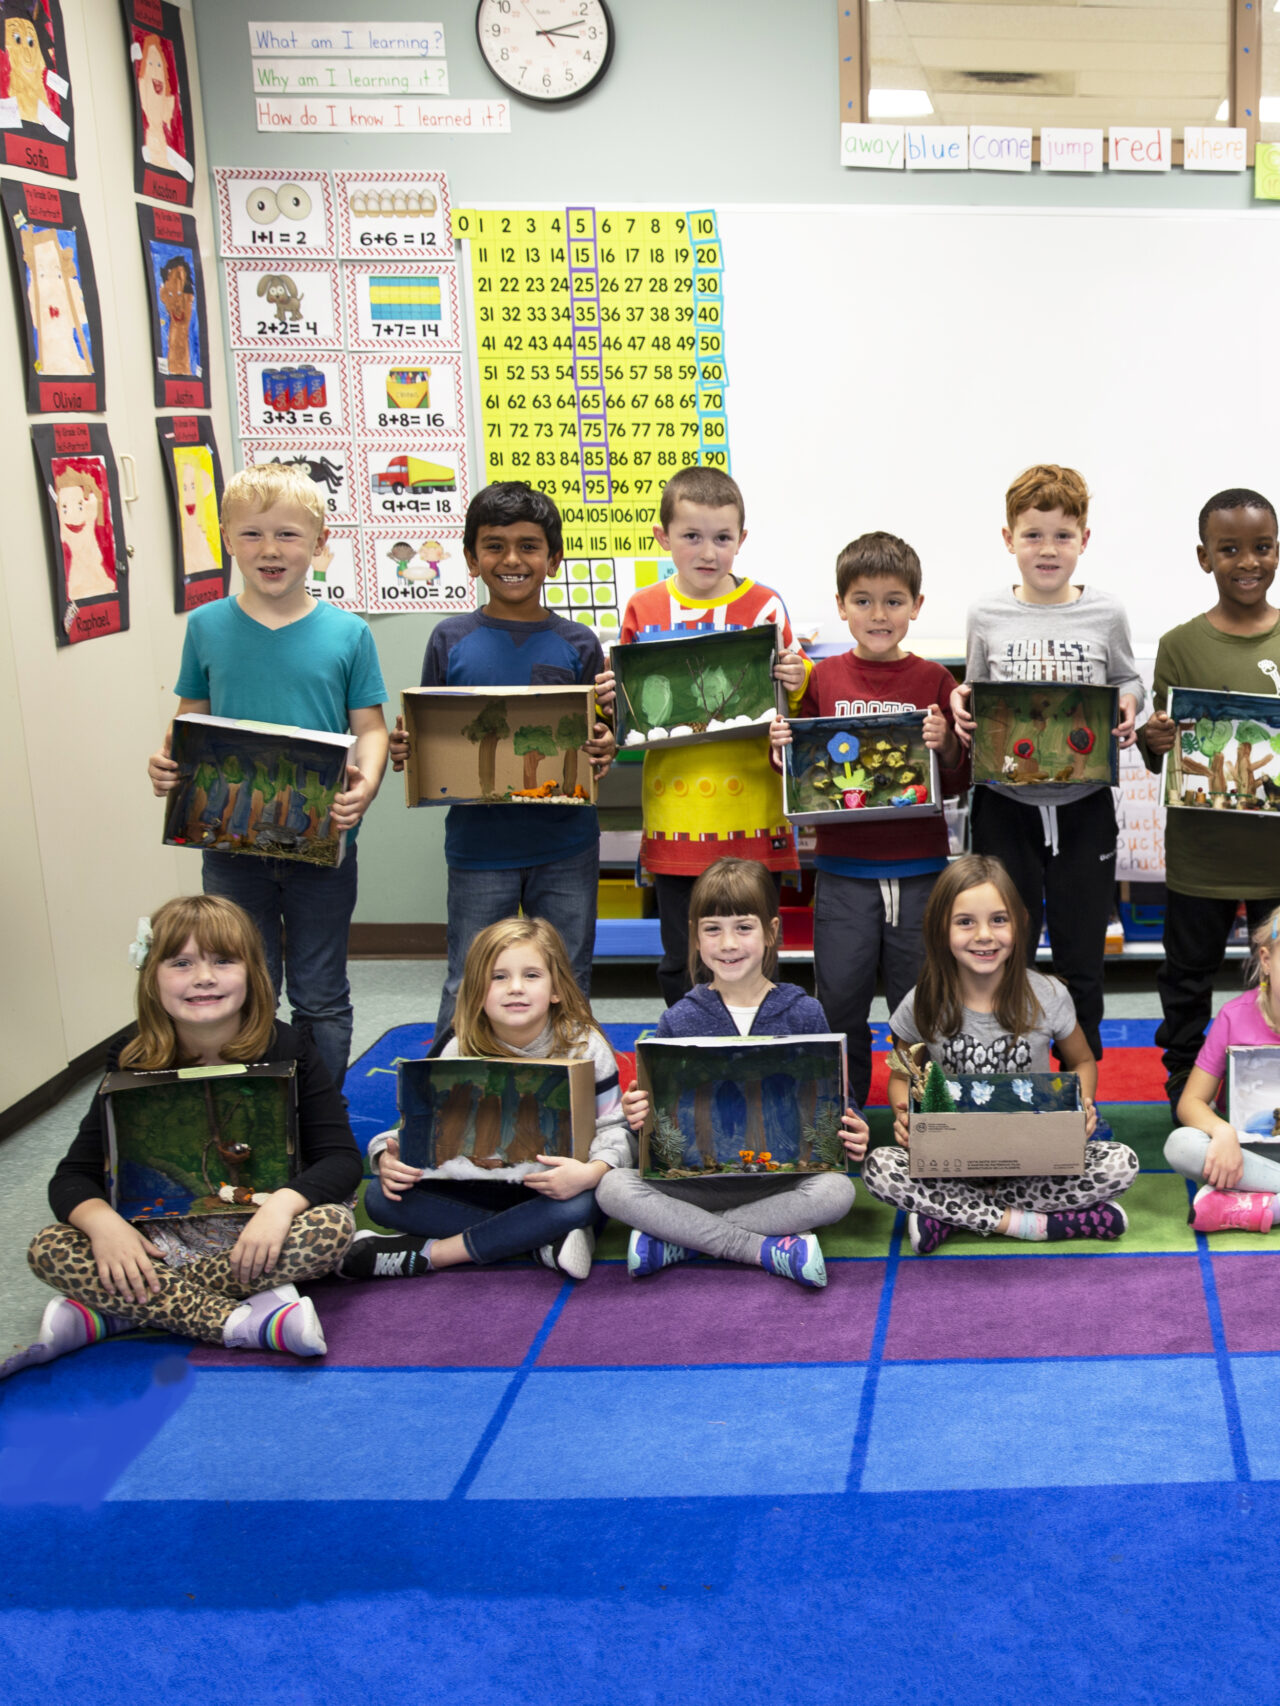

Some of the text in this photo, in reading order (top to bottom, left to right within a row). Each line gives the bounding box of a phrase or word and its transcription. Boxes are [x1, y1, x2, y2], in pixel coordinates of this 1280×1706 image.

[497, 0, 511, 13] 10
[580, 3, 588, 16] 2
[492, 24, 501, 37] 9
[588, 26, 597, 40] 3
[256, 30, 298, 48] What
[311, 36, 332, 48] am
[342, 31, 353, 48] I
[501, 47, 509, 60] 8
[583, 51, 591, 62] 4
[257, 69, 289, 92] Why
[298, 73, 319, 87] am
[326, 69, 336, 86] I
[349, 67, 409, 92] learning
[519, 66, 527, 79] 7
[565, 68, 574, 81] 5
[542, 74, 551, 87] 6
[258, 103, 292, 125] How
[301, 105, 318, 124] do
[327, 106, 337, 125] I
[350, 106, 384, 125] know
[394, 105, 406, 125] I
[419, 104, 471, 125] learned
[844, 136, 899, 165] away
[908, 134, 960, 159] blue
[1043, 134, 1094, 168] jump
[1115, 131, 1162, 162] red
[1187, 131, 1243, 160] where
[26, 147, 49, 168] Sofia
[458, 216, 469, 231] 0
[479, 218, 713, 233] 1 2 3 4 5 6 7 8 9 10
[296, 231, 307, 245] 2
[360, 232, 398, 246] 6+6
[420, 232, 437, 245] 12
[306, 322, 318, 335] 4
[422, 324, 439, 337] 14
[482, 336, 720, 351] 41 42 43 44 45 46 47 48 49 50
[53, 392, 82, 409] Olivia
[263, 411, 297, 424] 3+3
[320, 412, 332, 425] 6
[426, 413, 444, 427] 16
[436, 500, 451, 512] 18
[562, 509, 655, 523] 104 105 106 107
[445, 586, 466, 599] 20
[76, 612, 110, 636] Raphael
[1117, 810, 1161, 831] duck
[1119, 850, 1166, 871] chuck
